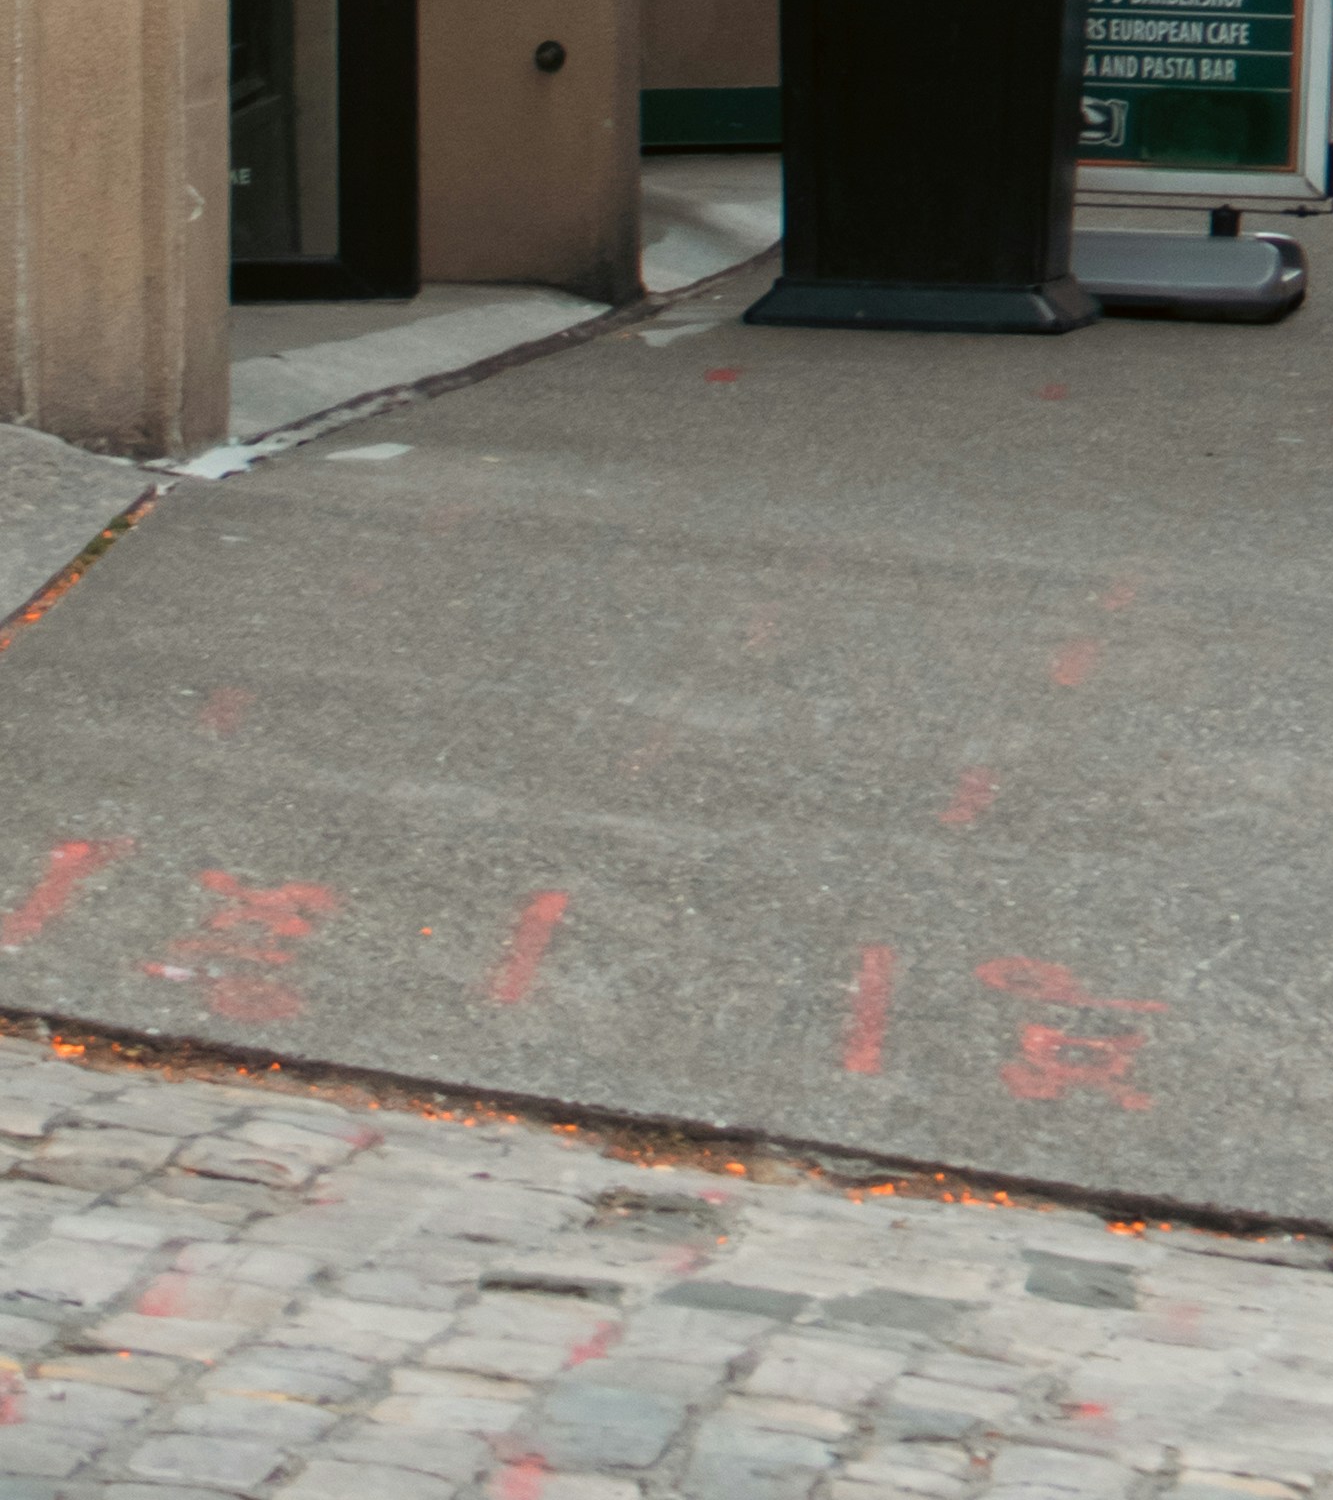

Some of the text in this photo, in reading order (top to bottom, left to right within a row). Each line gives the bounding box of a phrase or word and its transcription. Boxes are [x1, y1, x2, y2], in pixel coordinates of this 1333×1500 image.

[1109, 18, 1204, 44] EUROPEAN
[1205, 21, 1250, 46] CAFE
[1099, 55, 1139, 78] AND
[1141, 56, 1196, 80] PASTA
[1199, 58, 1237, 82] BAR
